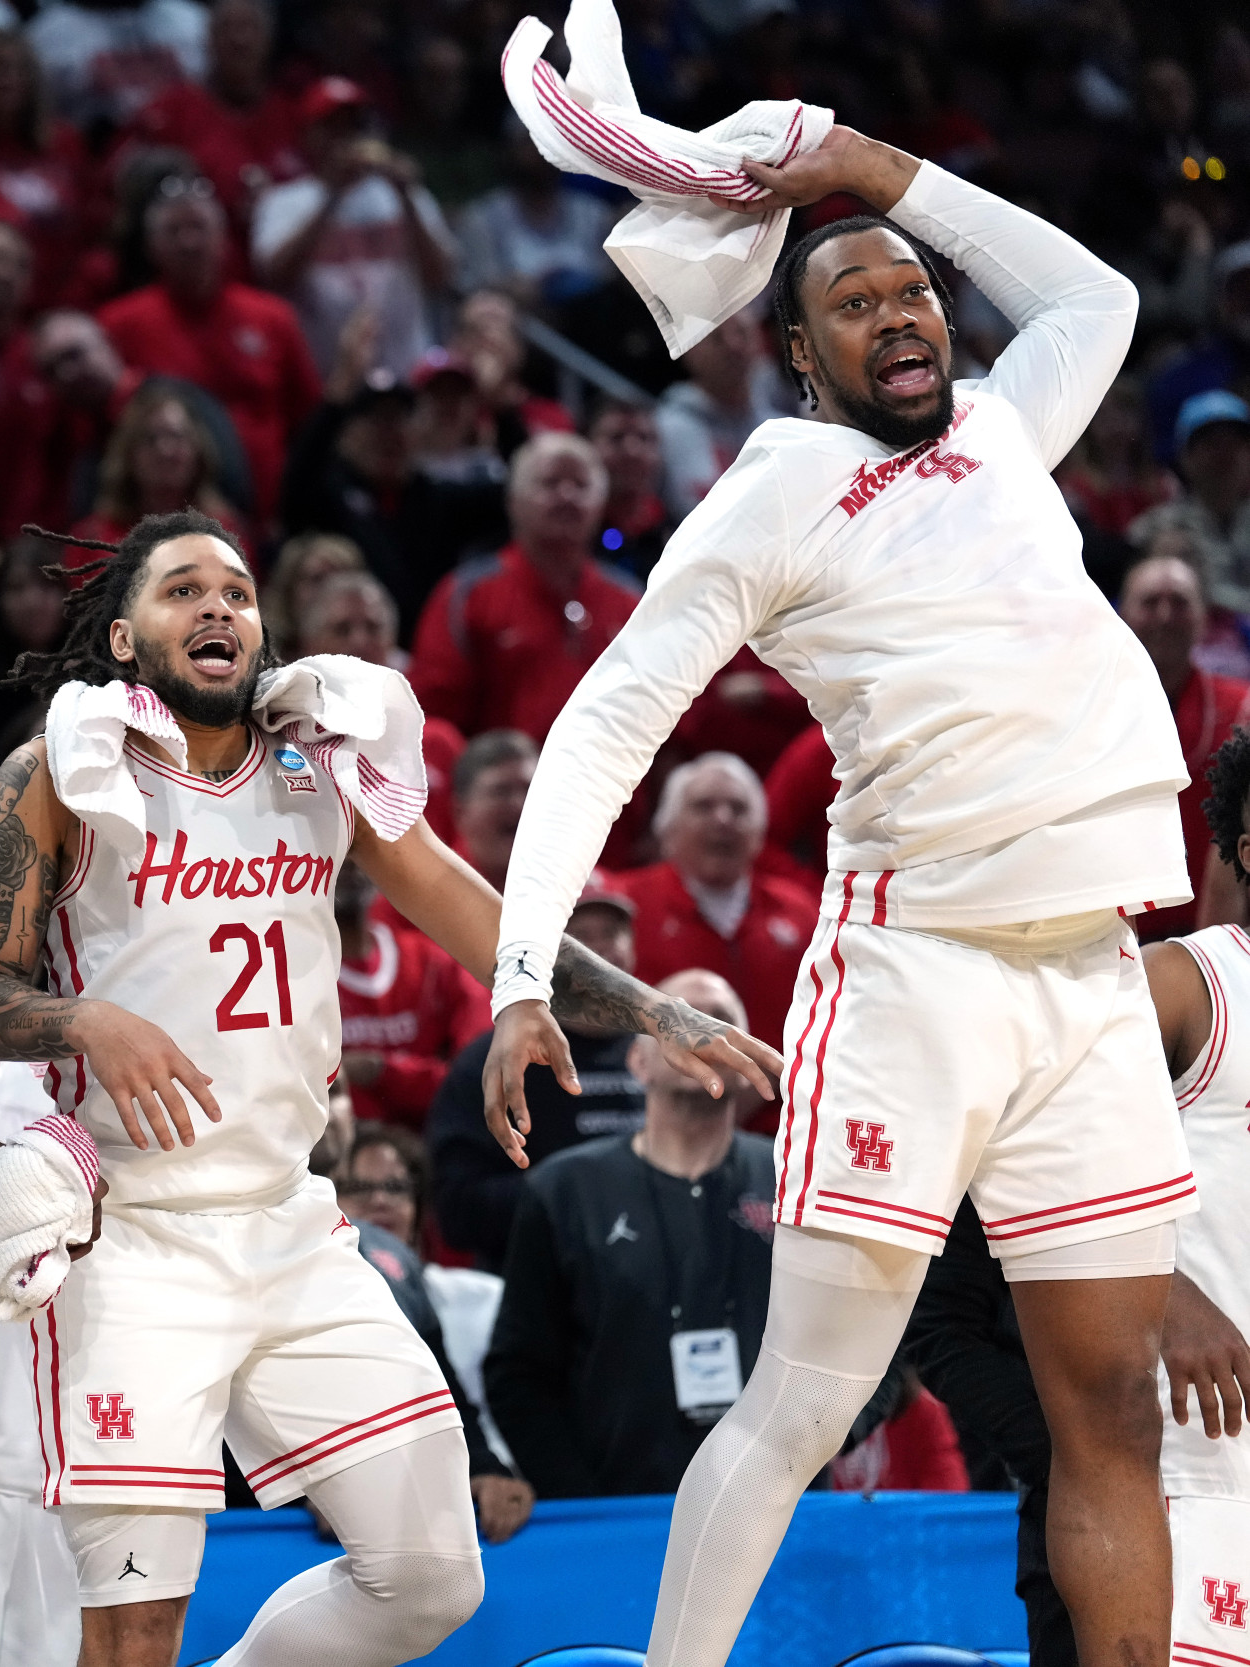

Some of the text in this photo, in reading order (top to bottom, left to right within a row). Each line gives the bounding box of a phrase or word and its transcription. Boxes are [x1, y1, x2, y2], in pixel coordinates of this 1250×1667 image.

[127, 828, 334, 909] Houston
[209, 920, 293, 1033] 21
[846, 1119, 894, 1172] UH
[86, 1393, 134, 1440] UH
[1202, 1576, 1249, 1630] UH
